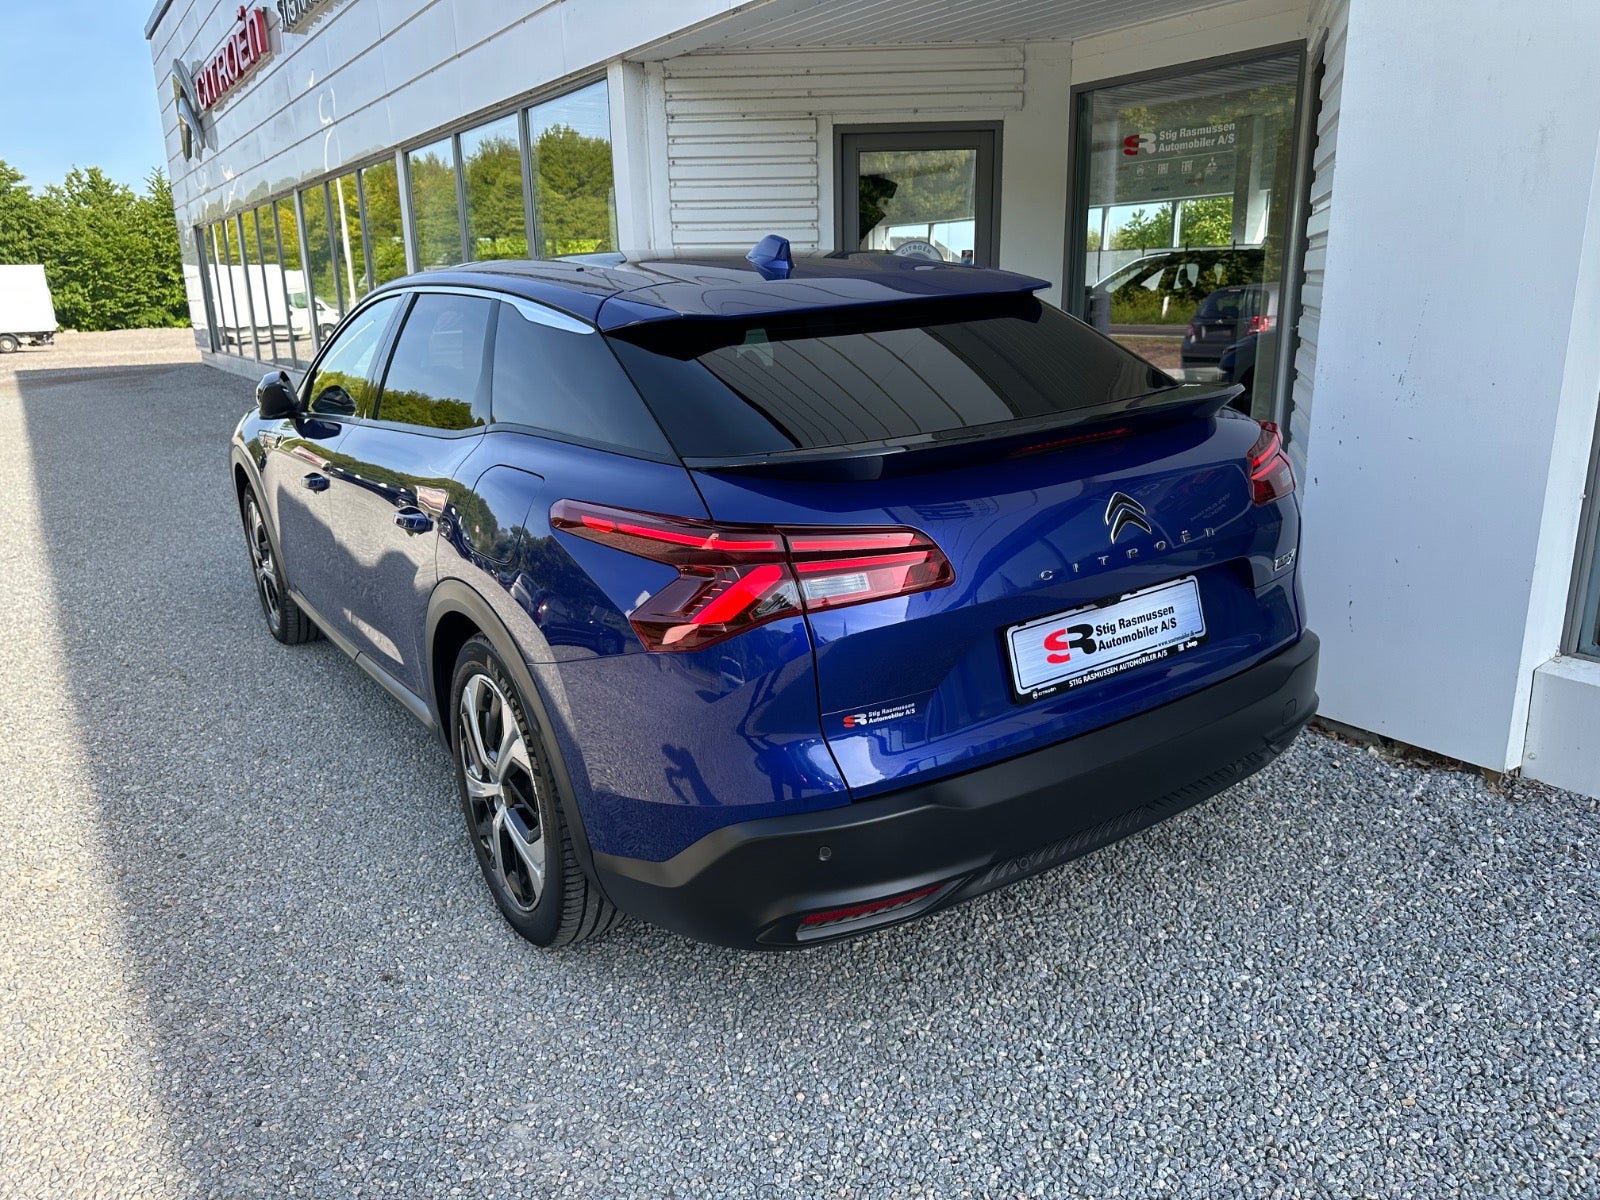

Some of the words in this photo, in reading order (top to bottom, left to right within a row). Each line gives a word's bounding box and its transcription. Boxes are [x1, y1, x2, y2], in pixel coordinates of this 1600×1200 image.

[196, 5, 268, 111] CITROËN
[1158, 137, 1215, 153] Automobiler
[1217, 133, 1235, 145] A/S
[1160, 130, 1177, 141] Stig
[1179, 123, 1235, 137] Rasmussen
[1039, 527, 1215, 581] CITROËN
[1096, 622, 1117, 637] Stig
[1118, 605, 1175, 630] Rasmussen
[1098, 625, 1159, 652] Automobiler
[1160, 617, 1177, 632] A/S
[1069, 678, 1083, 688] STIG
[1083, 665, 1119, 682] RASMUSSEN
[1119, 652, 1158, 672] AUTOMOBILER
[1157, 649, 1168, 659] A/S
[500, 677, 540, 770] MICHELIN
[868, 711, 905, 724] Automobiler
[905, 708, 916, 716] A/S
[881, 703, 915, 715] Rasmussen
